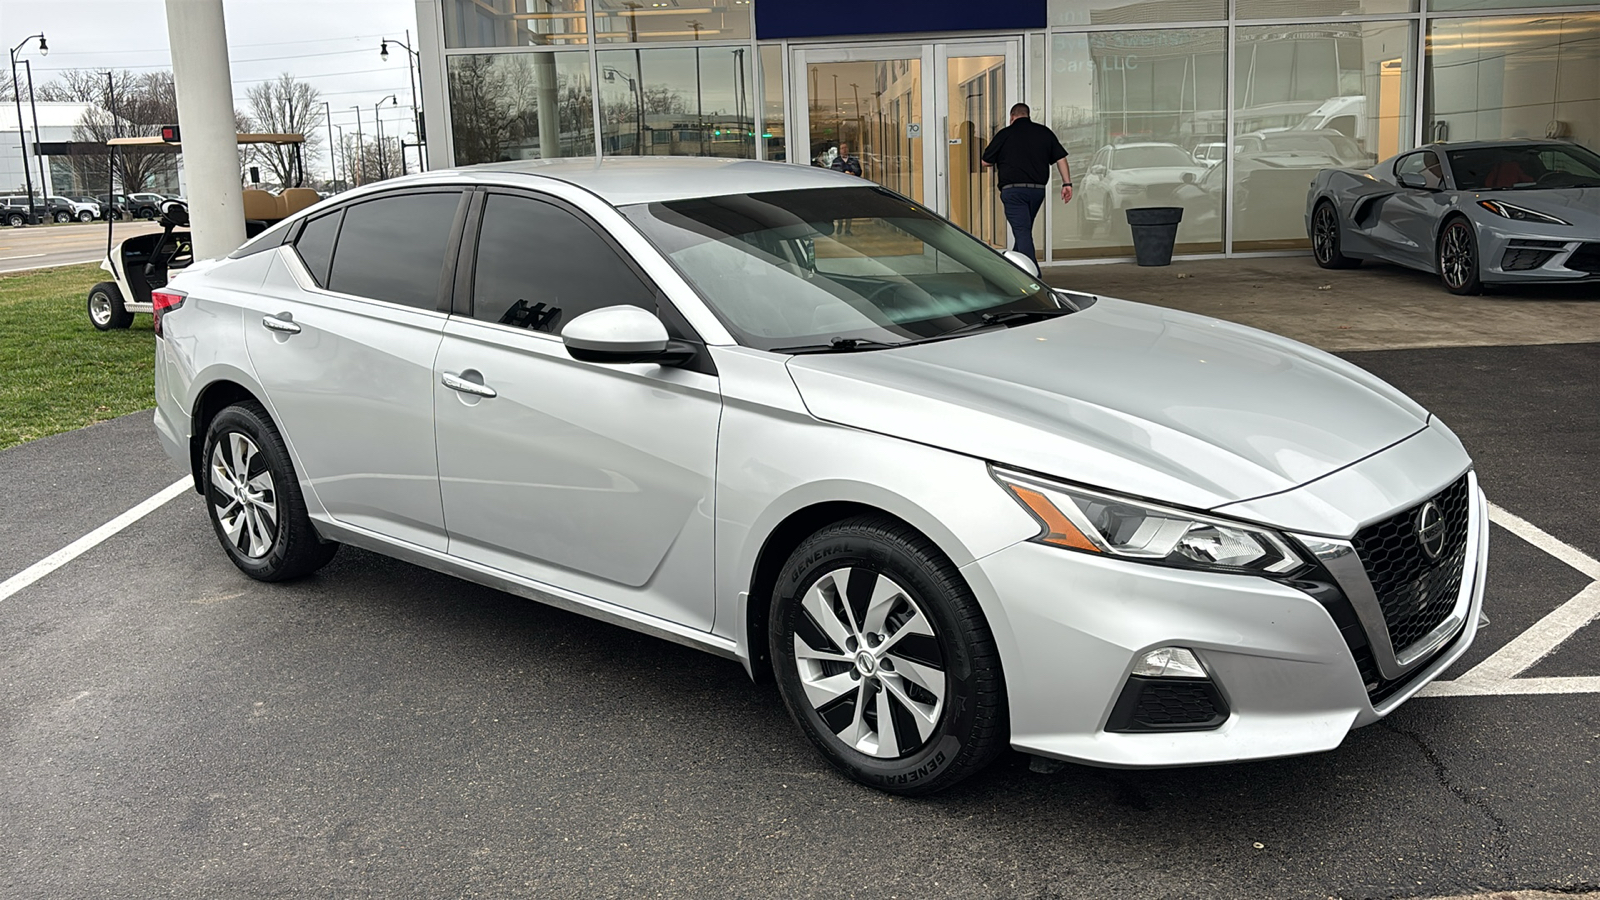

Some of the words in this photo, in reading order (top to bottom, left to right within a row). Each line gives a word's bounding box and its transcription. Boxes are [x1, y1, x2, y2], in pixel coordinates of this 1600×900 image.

[1054, 57, 1096, 73] Cars
[1102, 54, 1139, 71] LLC
[908, 123, 920, 133] 70
[791, 542, 854, 583] GENERAL
[875, 750, 947, 784] GENERAL
